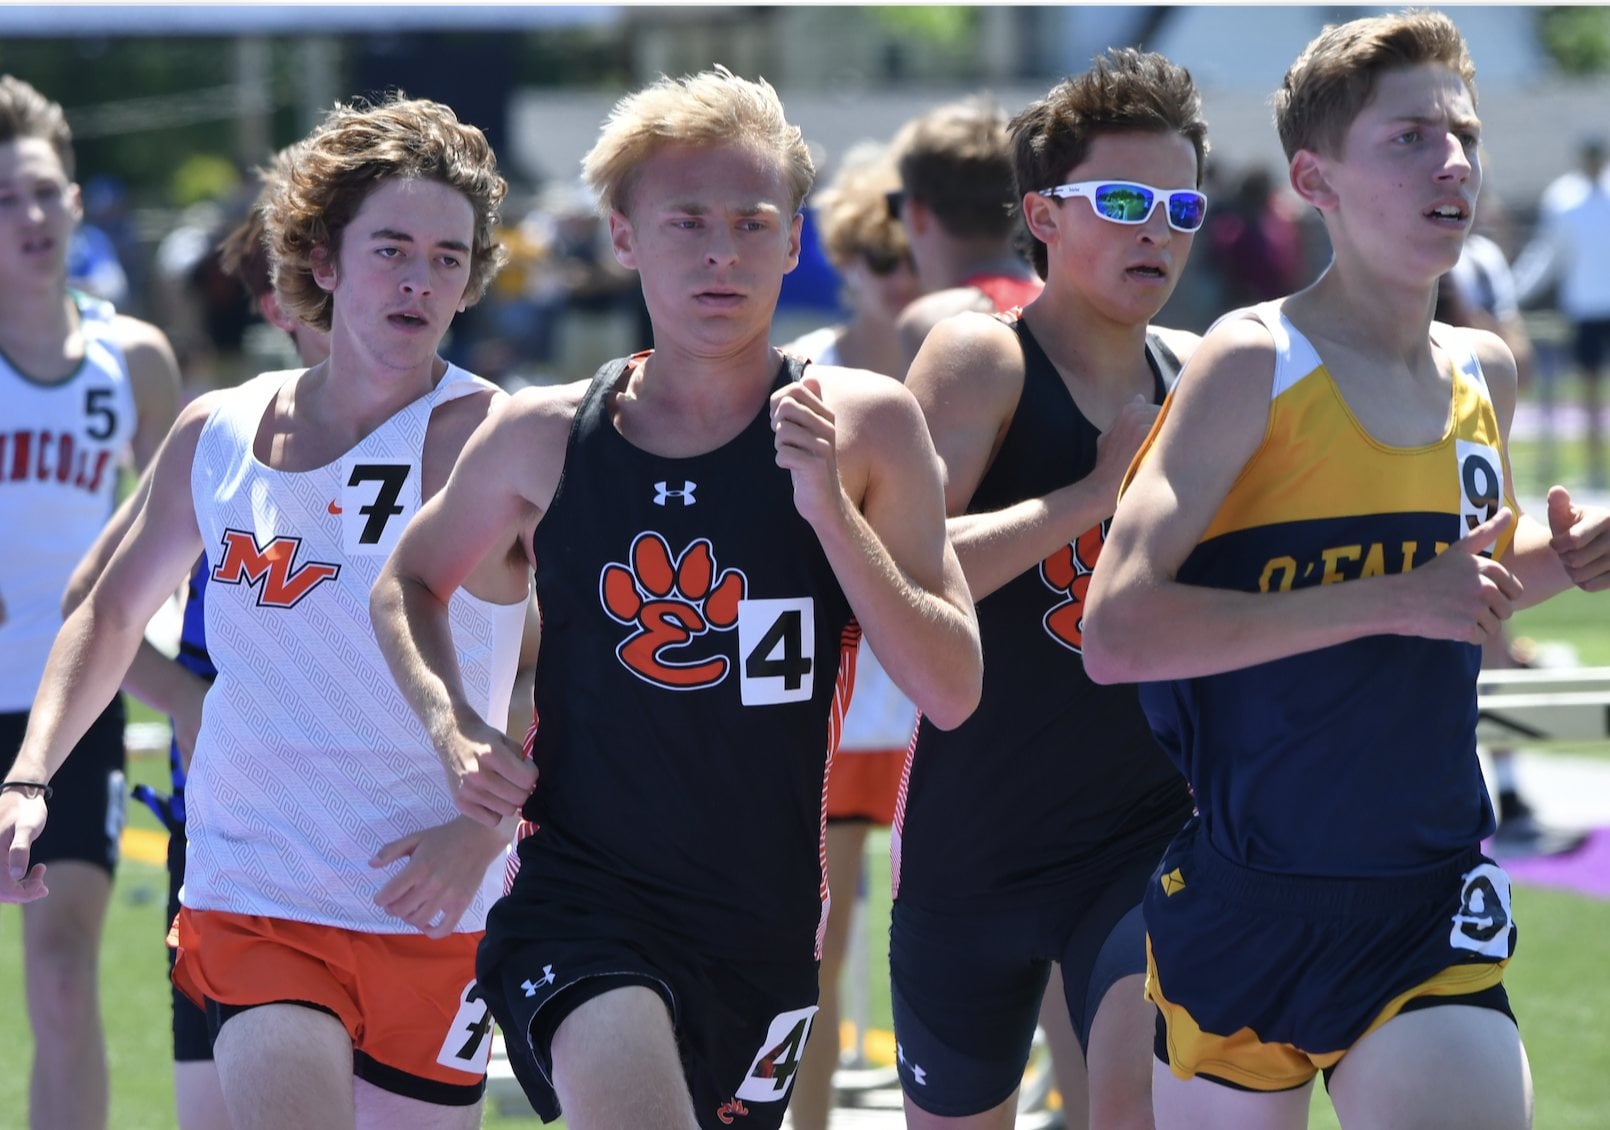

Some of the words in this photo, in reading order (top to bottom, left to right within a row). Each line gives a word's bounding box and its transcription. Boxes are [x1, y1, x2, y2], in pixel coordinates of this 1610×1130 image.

[85, 387, 117, 441] 5
[347, 464, 412, 545] 7
[1462, 454, 1499, 559] 9
[211, 527, 342, 609] MV
[1258, 540, 1450, 593] O'FA
[745, 609, 813, 691] 4
[1460, 875, 1508, 942] 9
[455, 984, 492, 1061] 7
[750, 1016, 808, 1092] 4
